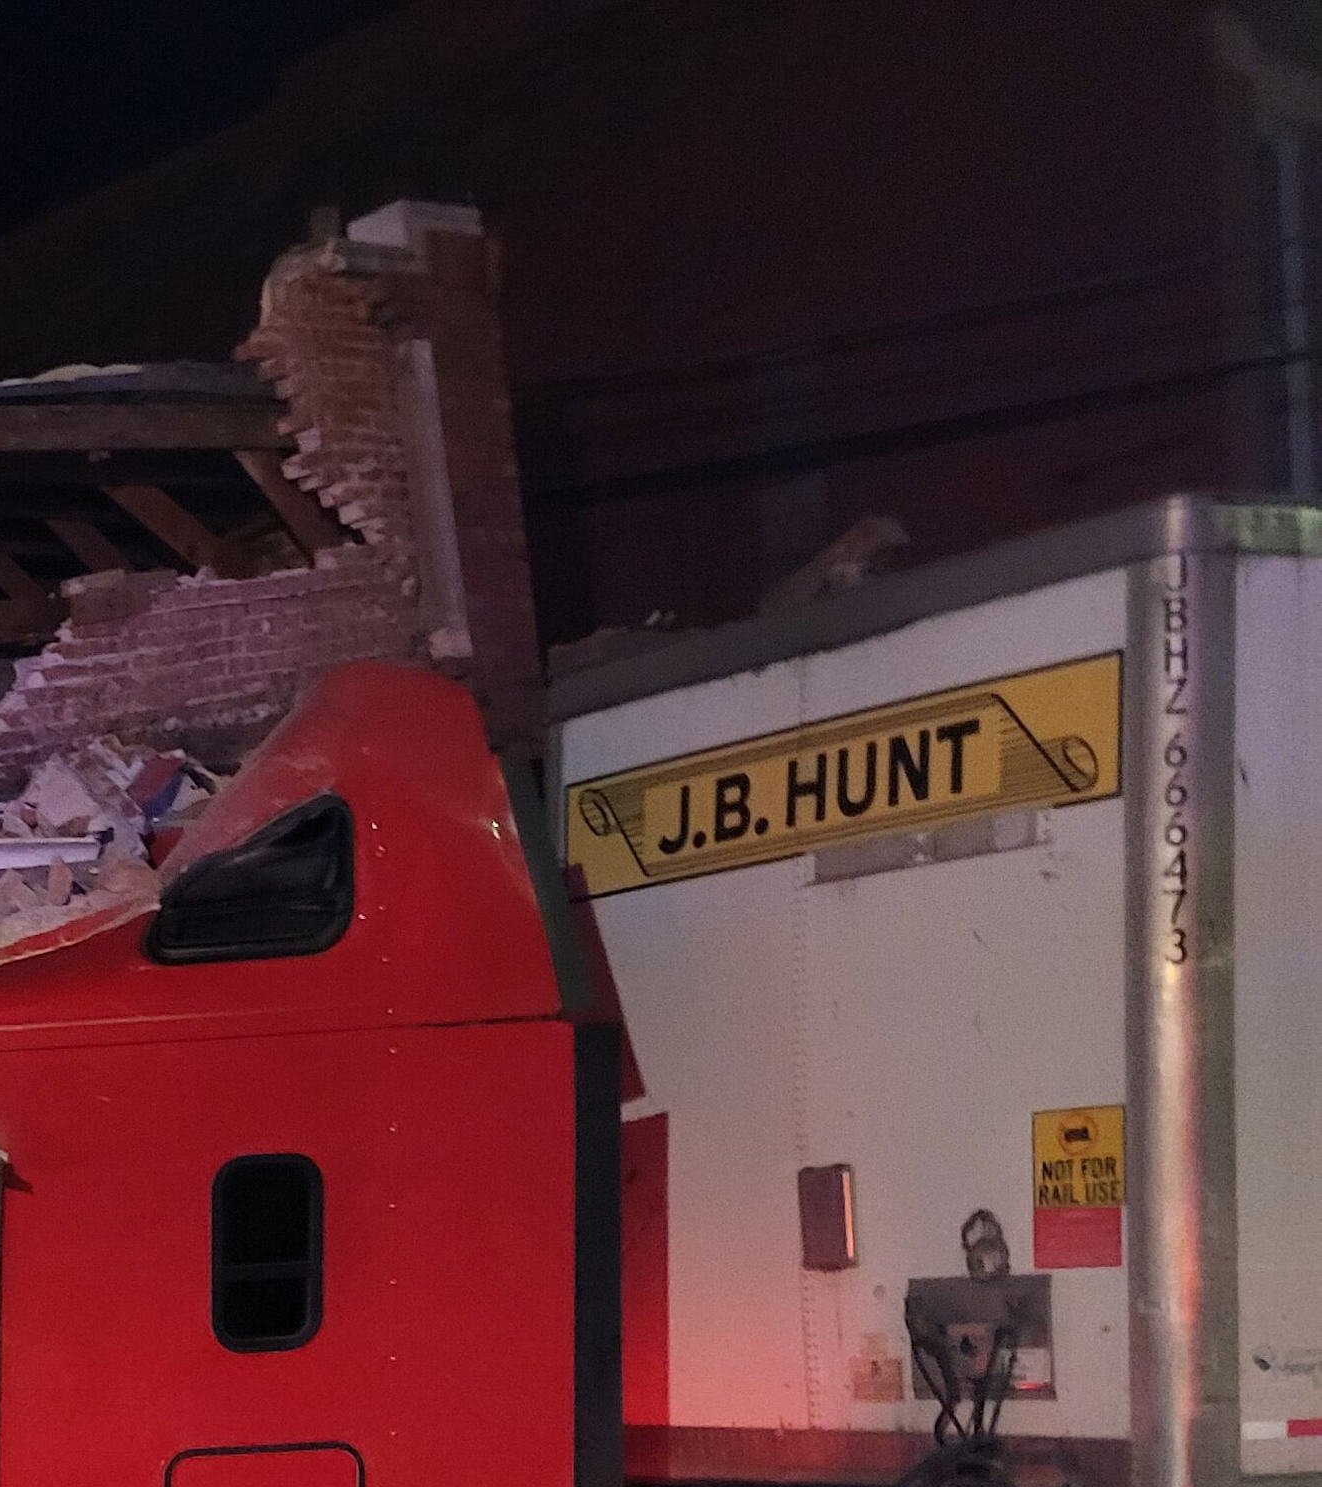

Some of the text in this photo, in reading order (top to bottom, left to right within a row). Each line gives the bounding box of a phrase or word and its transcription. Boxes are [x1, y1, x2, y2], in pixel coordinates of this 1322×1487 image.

[659, 718, 981, 855] J.B. HUNT
[1163, 553, 1190, 966] JBHZ 666473
[1038, 1179, 1121, 1206] RAIL USE
[1041, 1156, 1117, 1182] NOT FOR
